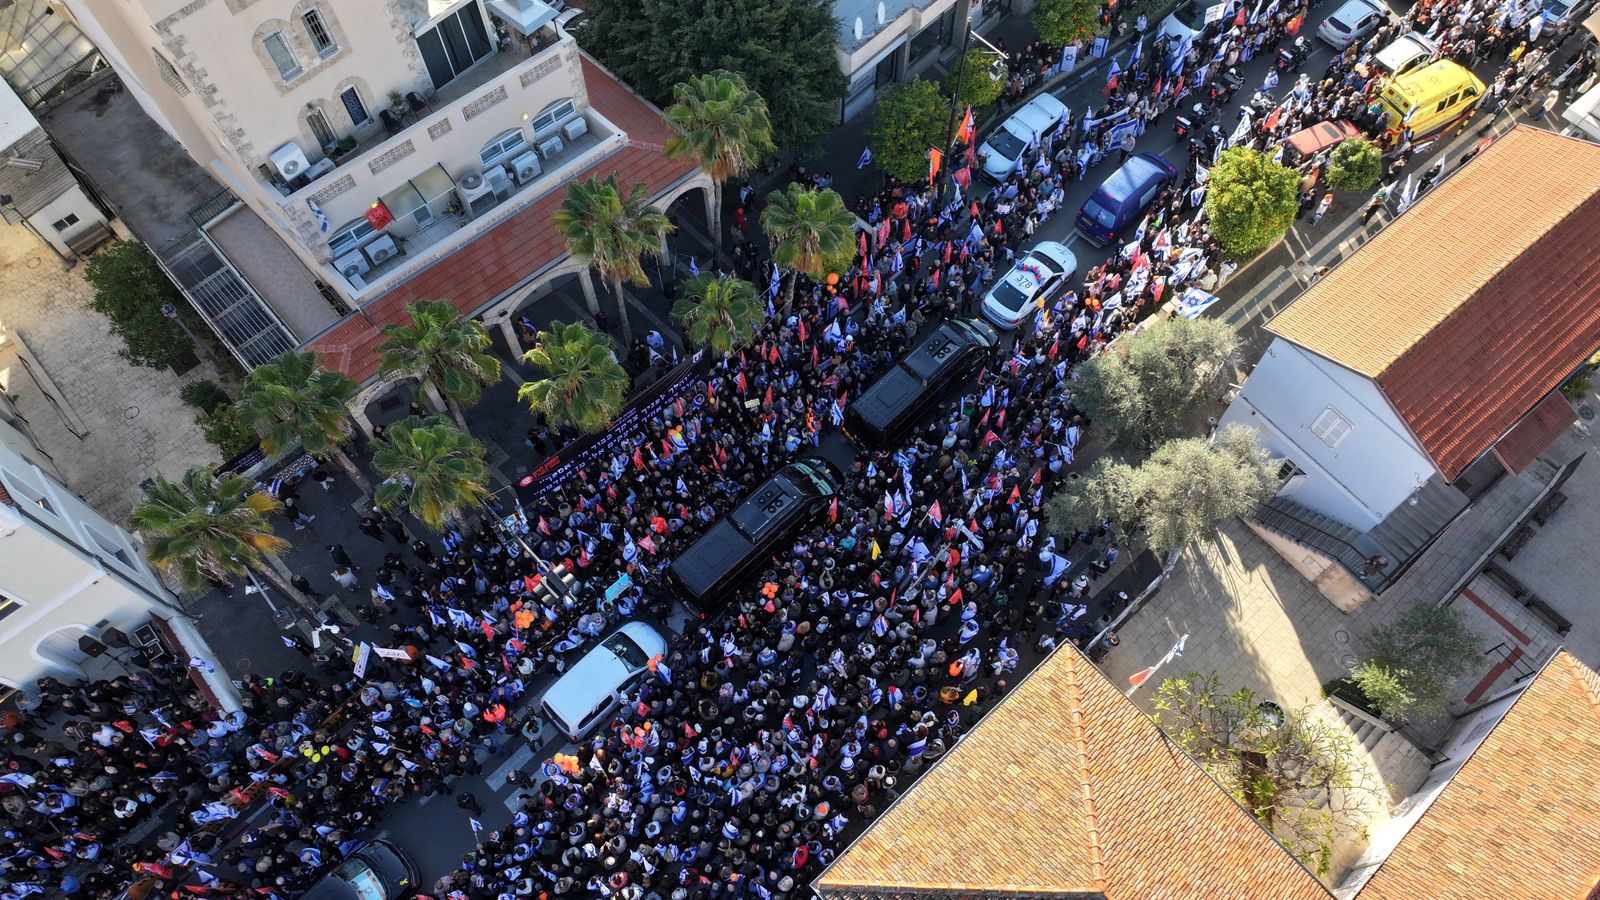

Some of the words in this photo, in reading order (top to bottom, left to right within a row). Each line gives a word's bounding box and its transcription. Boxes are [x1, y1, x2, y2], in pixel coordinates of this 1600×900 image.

[1016, 274, 1033, 289] 378
[641, 394, 666, 414] לפניך
[614, 415, 638, 433] צדקך
[591, 434, 613, 449] כבוד
[589, 448, 604, 460] אלי
[575, 462, 586, 471] מן
